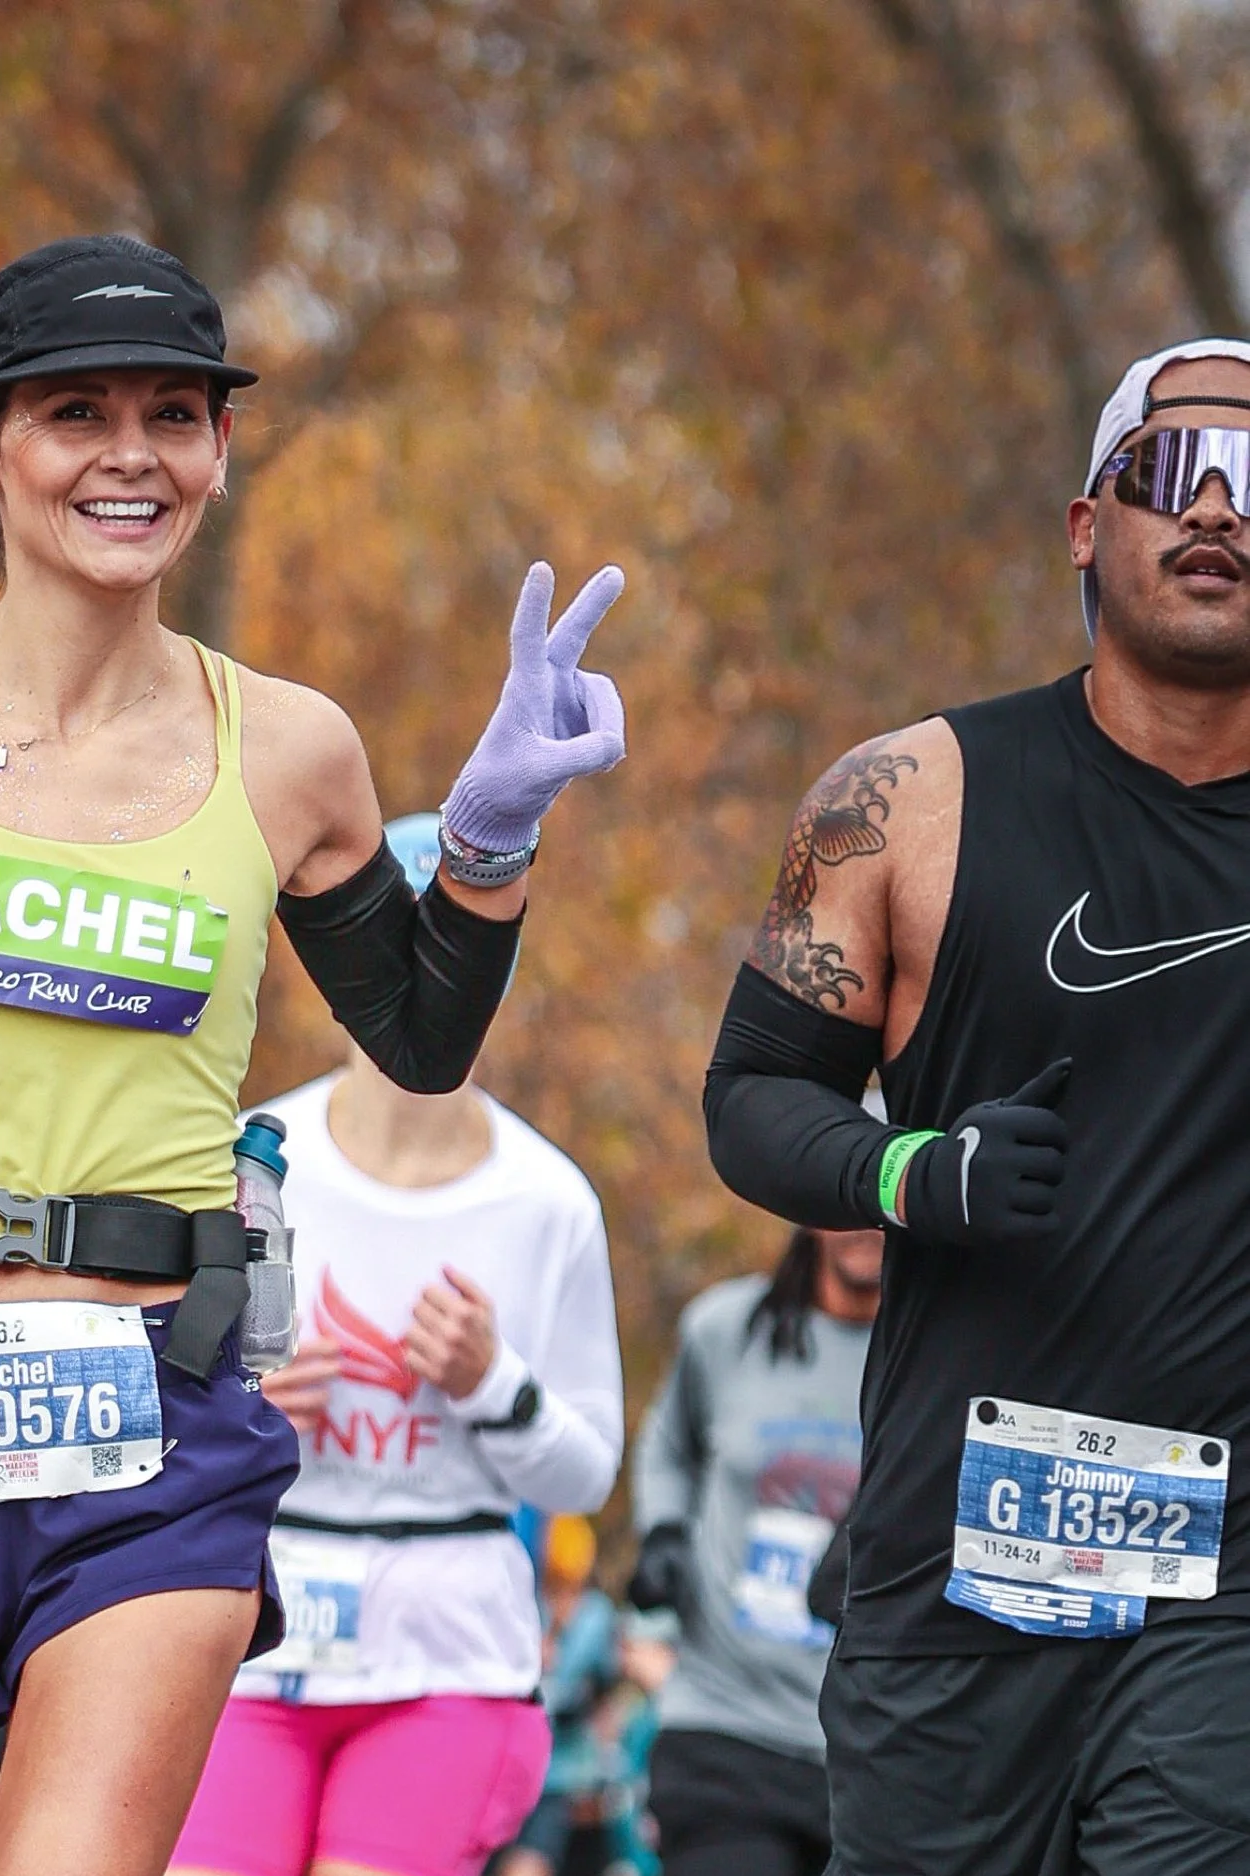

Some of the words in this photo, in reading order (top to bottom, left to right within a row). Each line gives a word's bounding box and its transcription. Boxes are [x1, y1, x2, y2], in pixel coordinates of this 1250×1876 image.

[1076, 1430, 1117, 1457] 26.2
[1046, 1459, 1136, 1499] Johnny
[988, 1478, 1021, 1532] G
[1041, 1488, 1191, 1549] 13522
[983, 1539, 1041, 1565] 11-24-24
